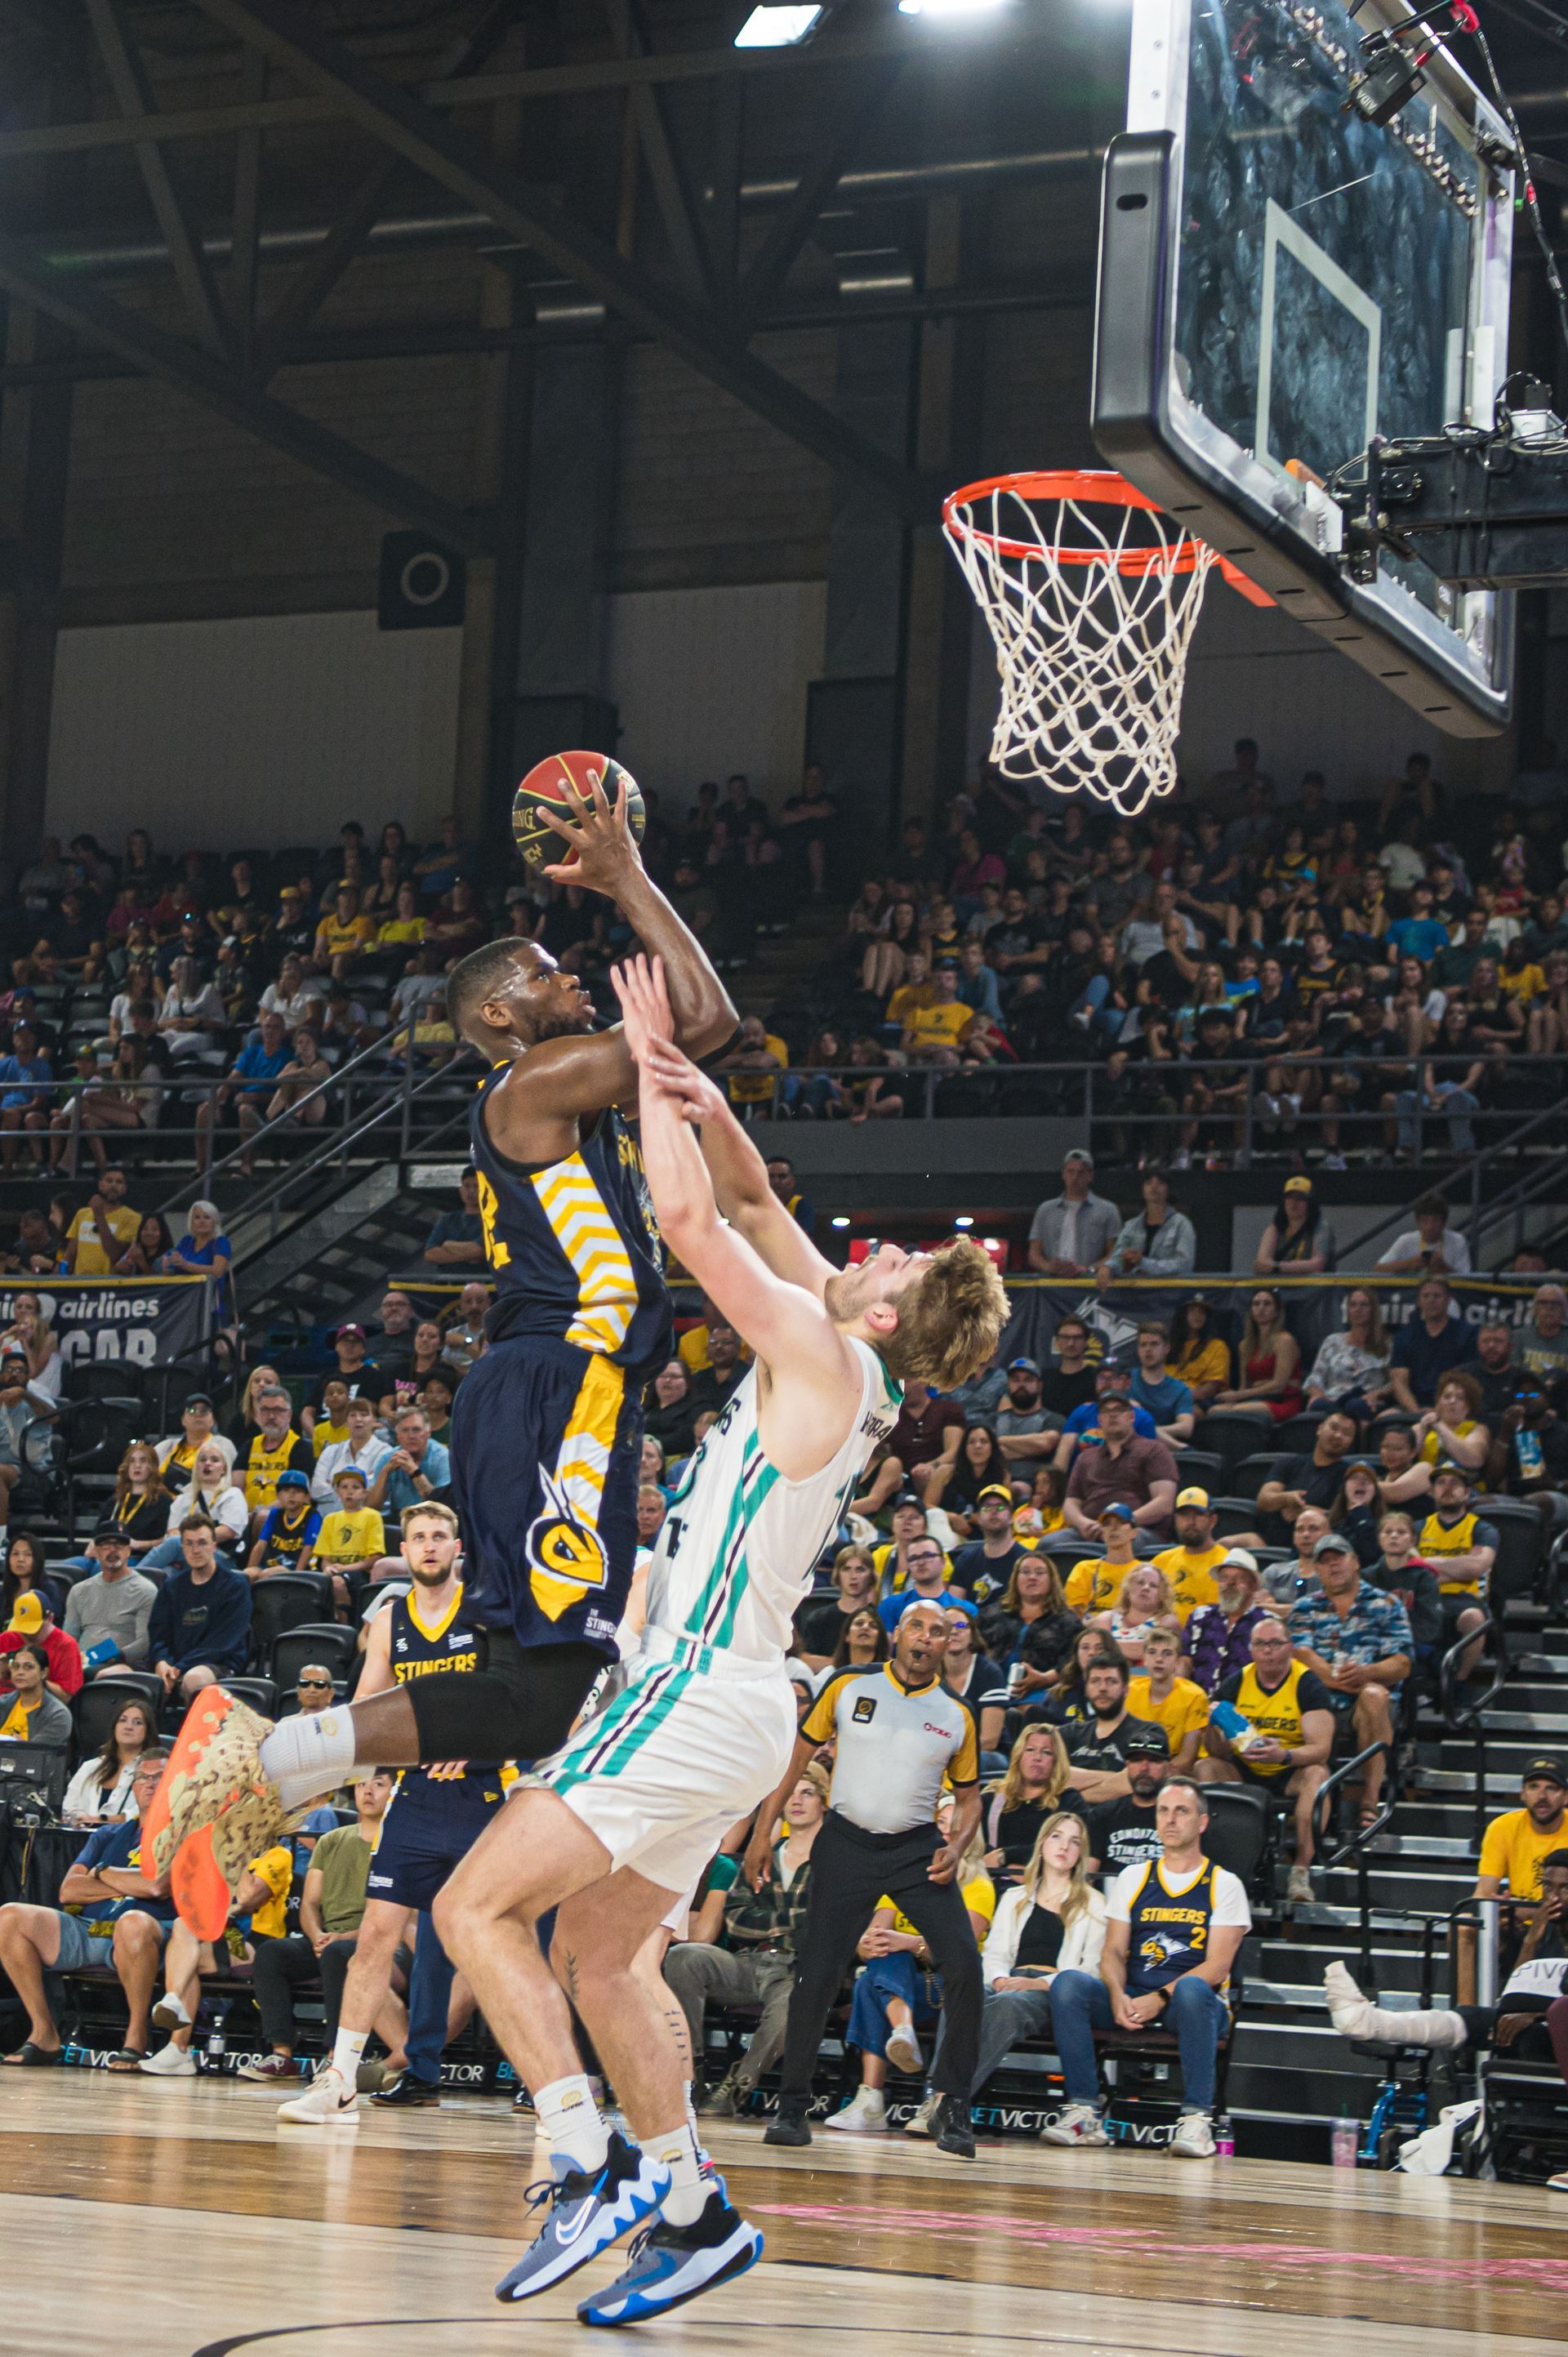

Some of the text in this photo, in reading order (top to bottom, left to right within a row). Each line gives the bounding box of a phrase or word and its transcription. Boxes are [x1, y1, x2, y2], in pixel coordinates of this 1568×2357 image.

[59, 1292, 159, 1319] airlines
[394, 1652, 478, 1684] STINGERS
[1107, 1844, 1165, 1858] STINGERS
[1140, 1907, 1207, 1925] STINGERS
[1189, 1926, 1207, 1949] 2
